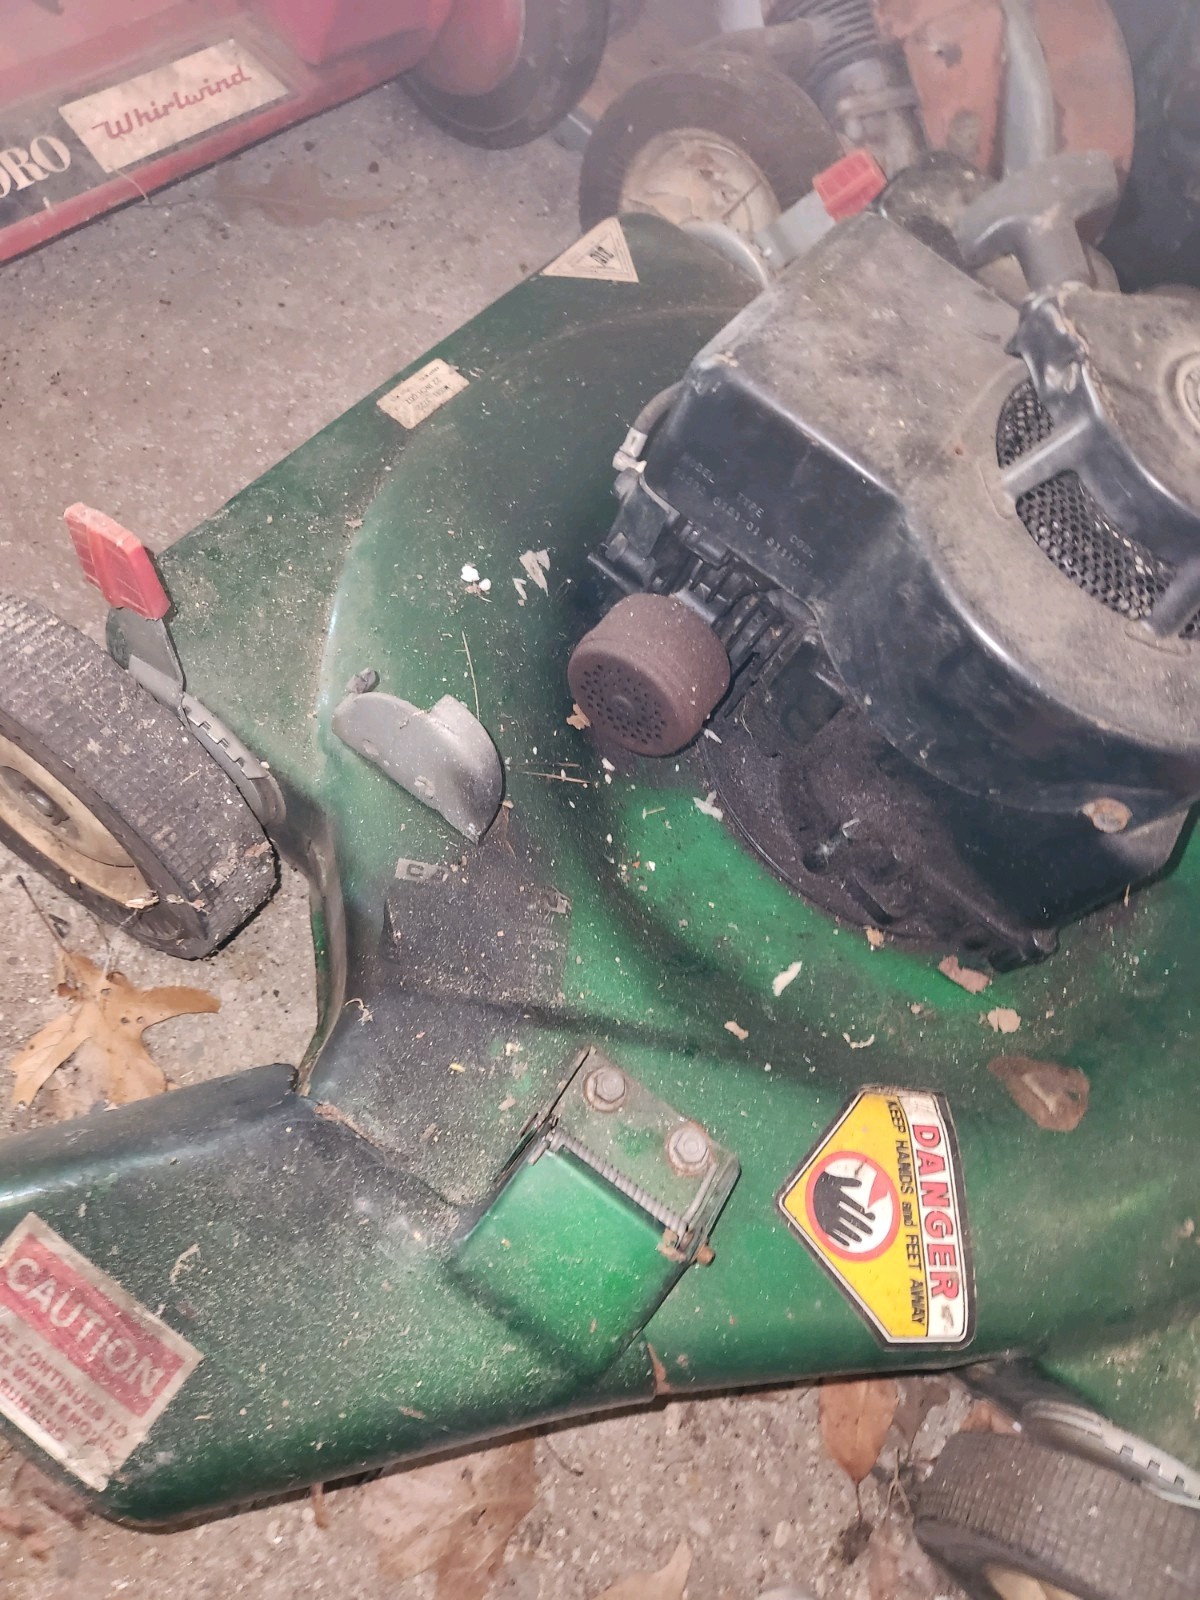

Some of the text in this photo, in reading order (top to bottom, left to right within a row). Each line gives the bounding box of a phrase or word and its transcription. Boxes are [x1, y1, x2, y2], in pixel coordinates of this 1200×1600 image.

[91, 65, 252, 141] Whirlwind
[737, 492, 765, 518] TYPE
[887, 1100, 907, 1135] KEEP
[895, 1139, 915, 1196] HANDS
[912, 1124, 960, 1302] DANGER
[905, 1234, 922, 1272] FEET
[6, 1257, 166, 1397] CAUTION
[909, 1279, 926, 1326] AWAY
